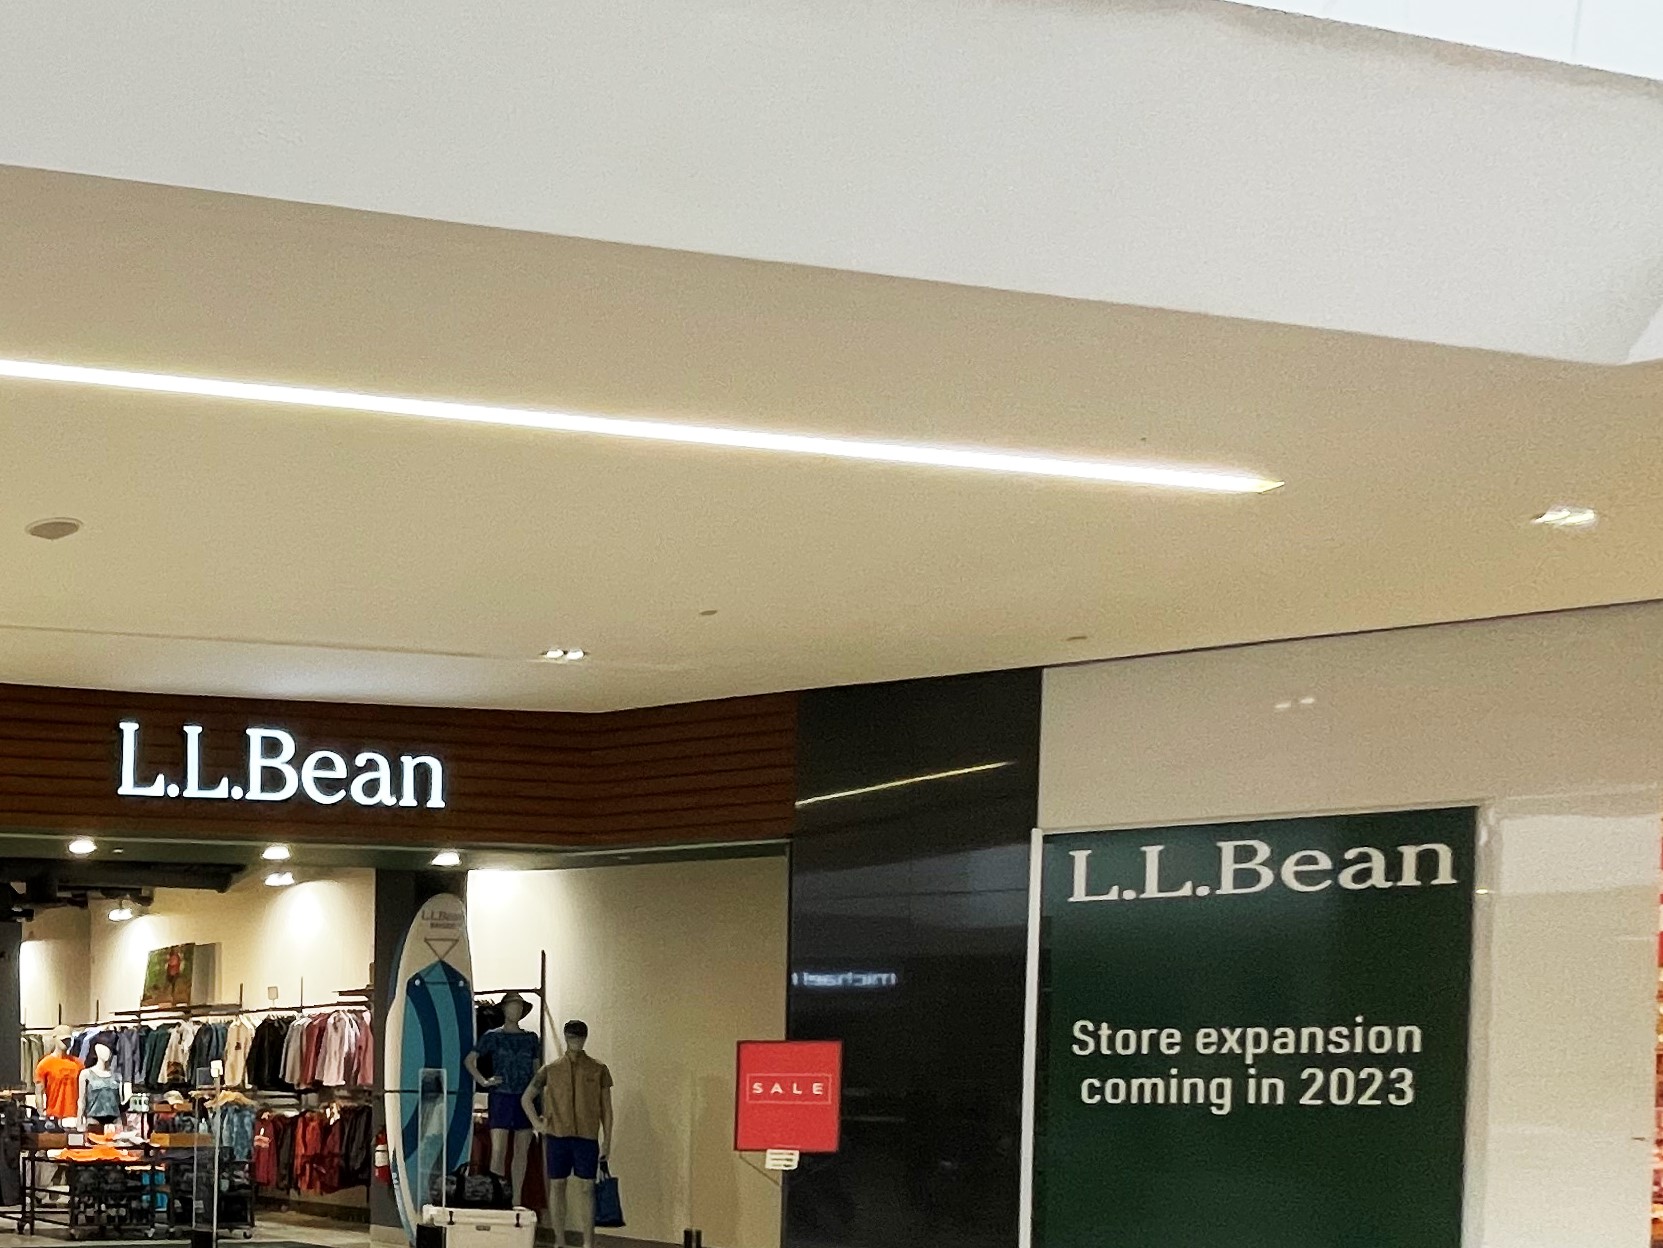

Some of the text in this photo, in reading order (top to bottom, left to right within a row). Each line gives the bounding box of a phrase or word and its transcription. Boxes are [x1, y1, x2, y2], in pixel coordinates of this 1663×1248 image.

[117, 721, 446, 809] L.L.Bean
[1068, 839, 1458, 903] L.L.Bean
[1071, 1015, 1423, 1064] Store expansion
[752, 1082, 824, 1095] SALE
[1080, 1067, 1415, 1116] coming in 2023
